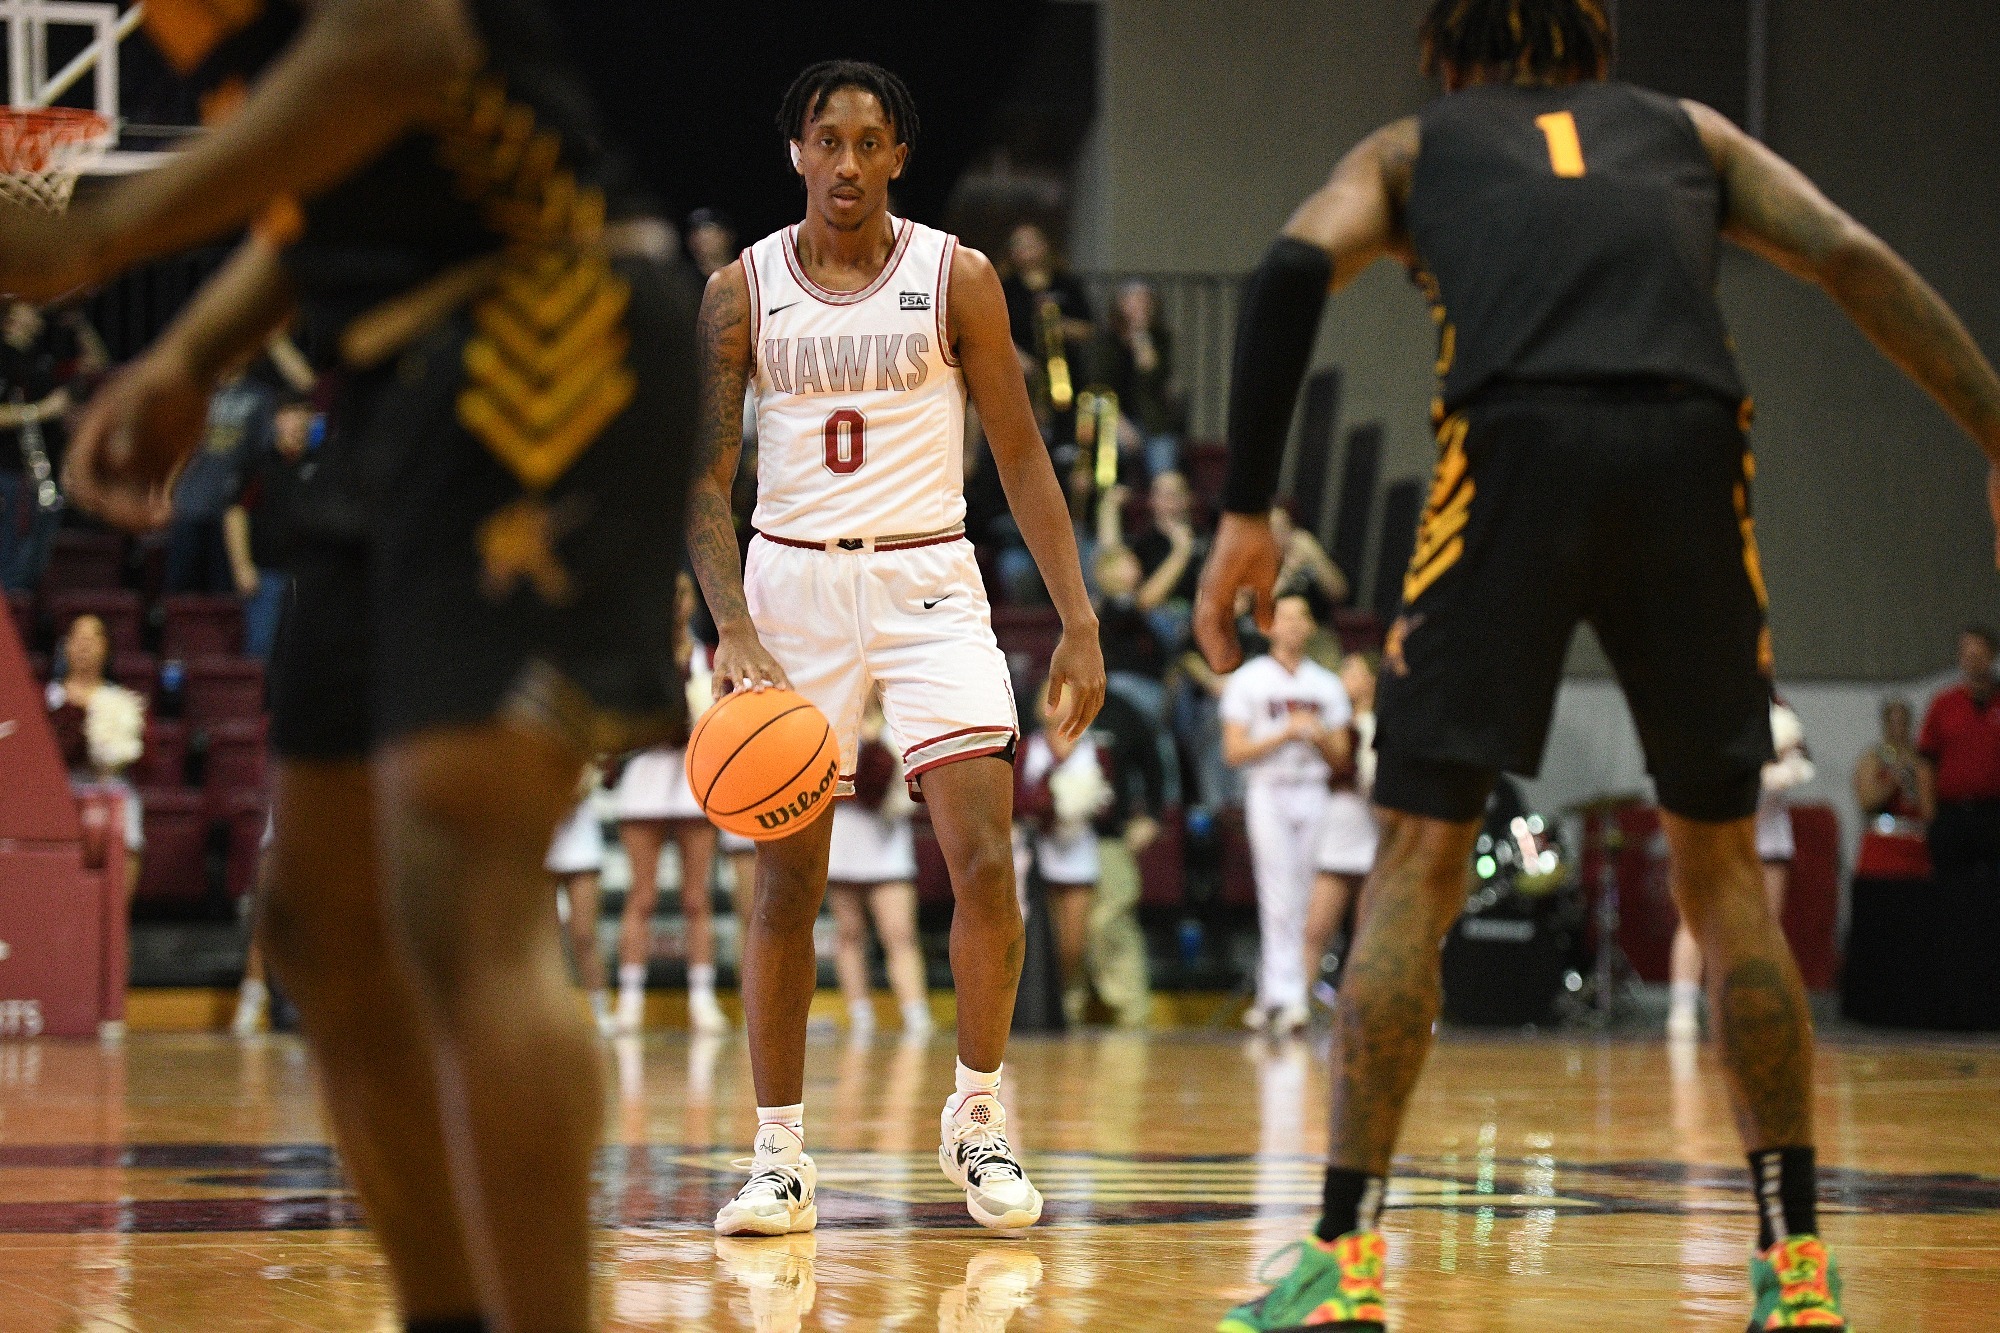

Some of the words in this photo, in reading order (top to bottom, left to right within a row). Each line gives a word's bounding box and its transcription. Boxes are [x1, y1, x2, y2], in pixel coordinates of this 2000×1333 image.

[1534, 110, 1587, 178] 1
[900, 296, 931, 306] PSAC
[765, 333, 929, 395] HAWKS
[822, 405, 868, 477] 0
[755, 759, 838, 829] Wilson
